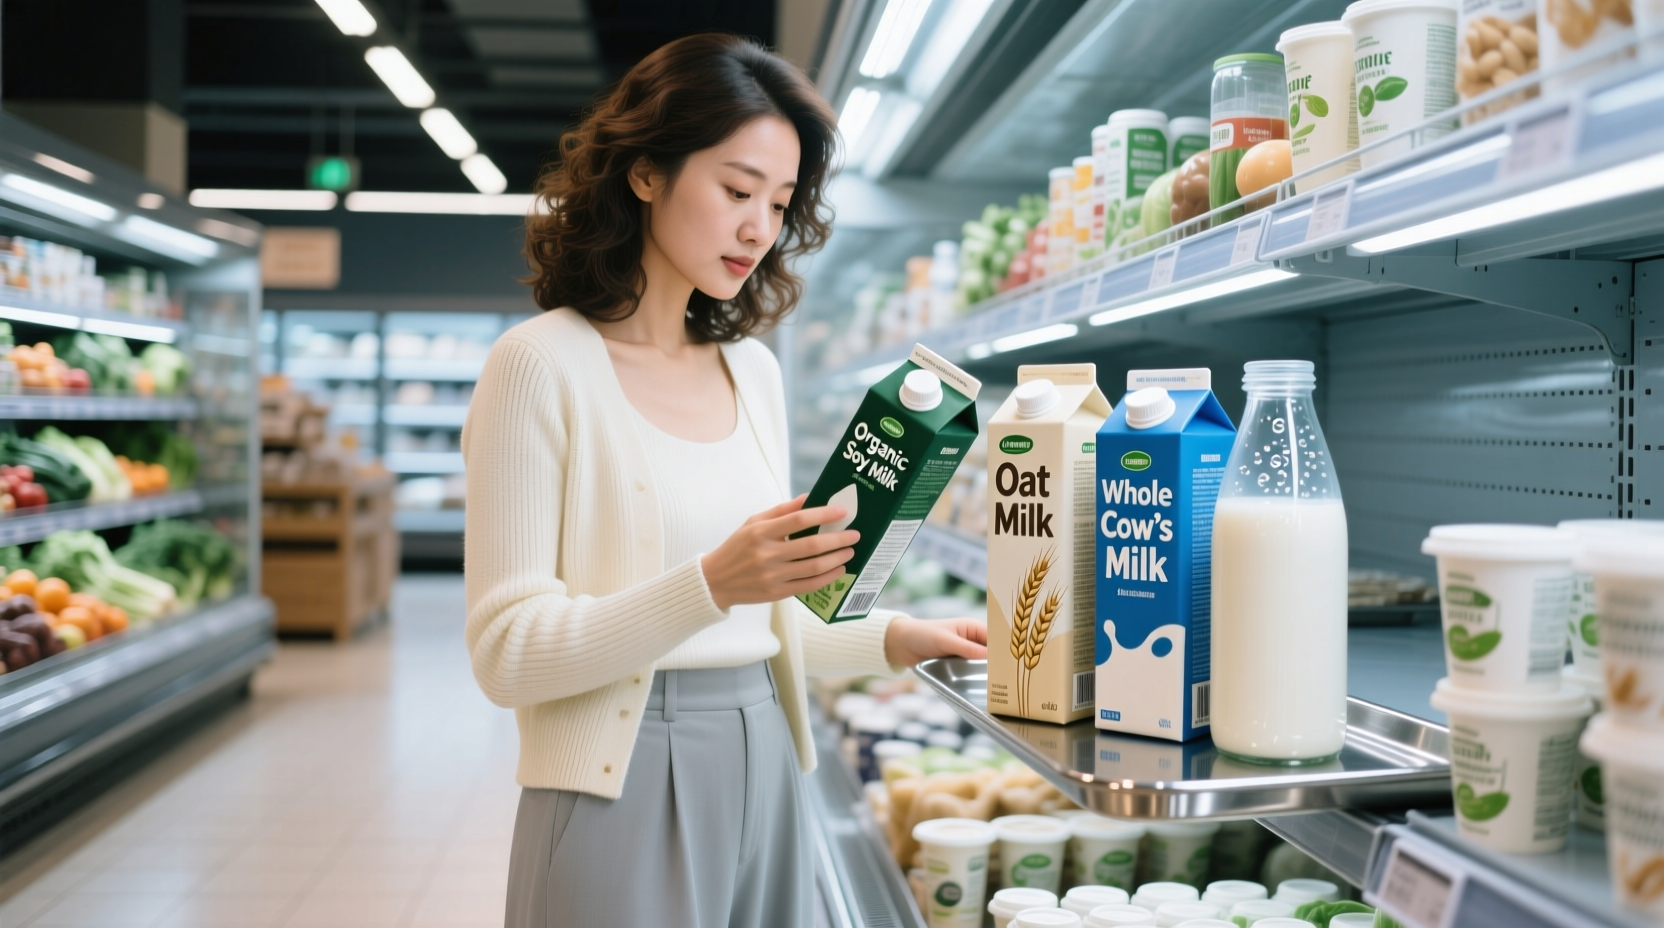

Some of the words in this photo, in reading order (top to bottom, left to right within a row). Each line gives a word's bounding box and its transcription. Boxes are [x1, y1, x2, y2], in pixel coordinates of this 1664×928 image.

[854, 421, 910, 471] Organic
[842, 440, 871, 473] Soy
[867, 460, 899, 492] Milk
[995, 461, 1051, 498] Oat
[1101, 478, 1173, 508] Whole
[994, 501, 1055, 539] Milk
[1100, 509, 1174, 542] Cow's
[1105, 545, 1169, 583] Milk
